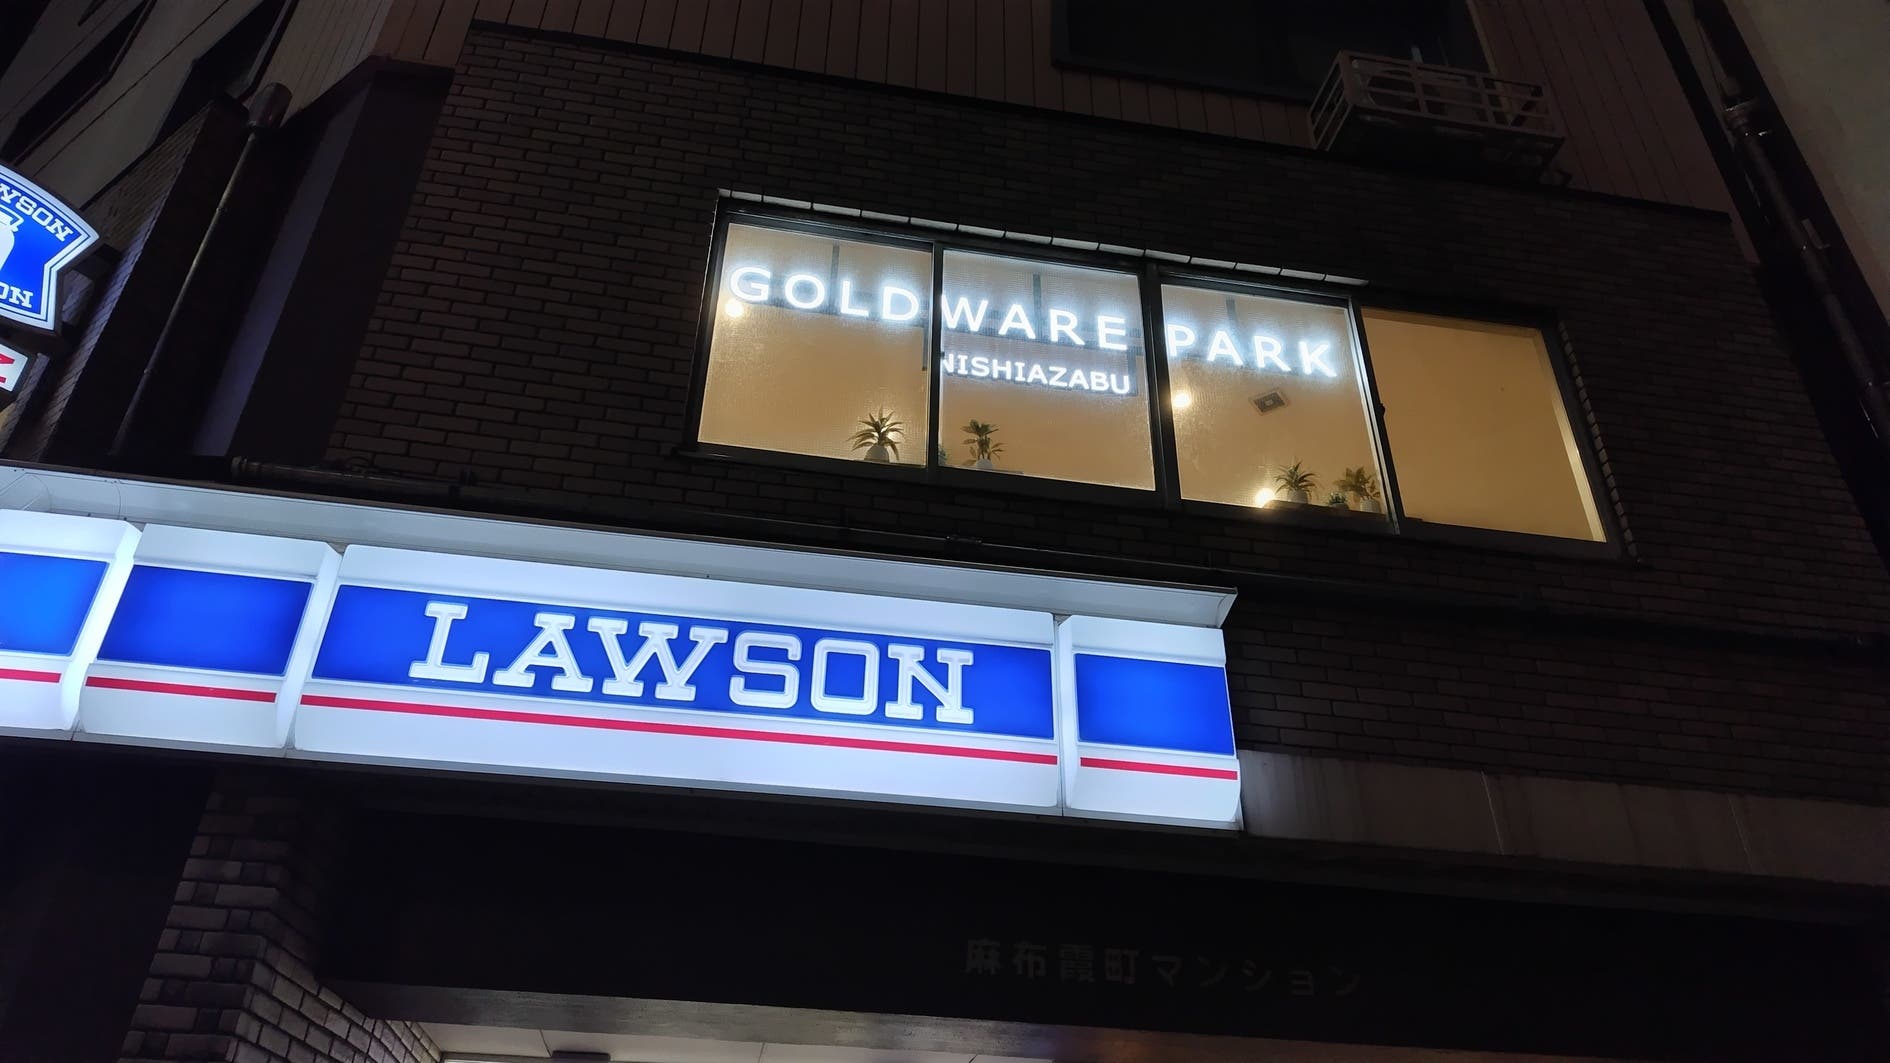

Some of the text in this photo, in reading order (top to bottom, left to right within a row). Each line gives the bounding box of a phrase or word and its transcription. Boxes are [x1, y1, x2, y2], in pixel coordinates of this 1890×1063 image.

[942, 353, 1130, 395] NISHIAZABU
[1166, 323, 1337, 378] PARK
[408, 601, 974, 724] LAWSON
[963, 937, 1361, 998] 麻布霞町マンション
